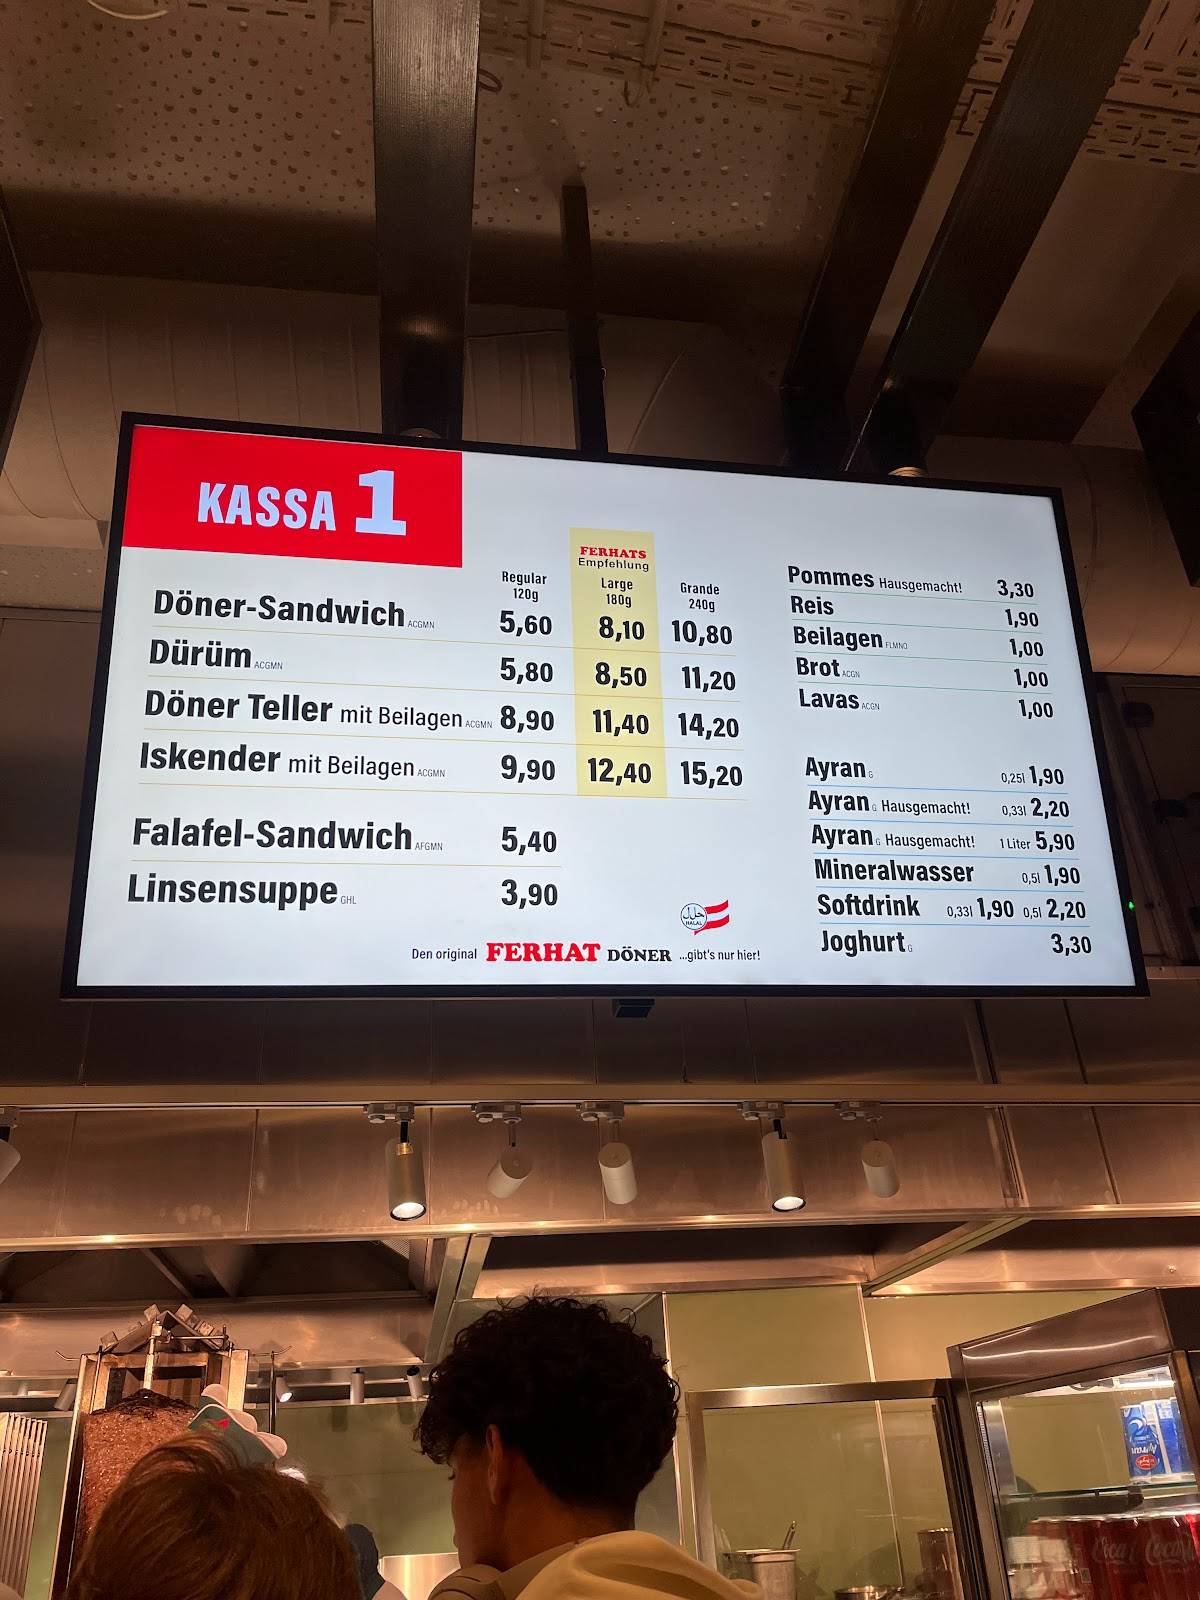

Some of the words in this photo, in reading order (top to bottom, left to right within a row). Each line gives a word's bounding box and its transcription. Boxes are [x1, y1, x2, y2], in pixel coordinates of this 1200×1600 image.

[197, 482, 336, 531] KASSA
[355, 469, 406, 536] 1
[578, 557, 649, 573] Empfehlung
[580, 546, 647, 560] FERHATS
[502, 570, 547, 586] Regular
[601, 577, 633, 593] Large
[680, 582, 720, 595] Grande
[787, 565, 875, 588] Pommes
[879, 577, 963, 594] Hausgemacht!
[996, 579, 1034, 599] 3,30
[154, 589, 405, 627] Döner-Sandwich
[513, 587, 539, 603] 120g
[606, 593, 632, 609] 180g
[688, 598, 715, 613] 240g
[790, 595, 834, 616] Reis
[499, 610, 552, 637] 5,60
[599, 615, 645, 643] 8,10
[1004, 608, 1039, 629] 1,90
[671, 619, 733, 647] 10,80
[793, 625, 883, 652] Beilagen
[149, 639, 252, 668] Dürüm
[1009, 638, 1044, 658] 1,00
[500, 657, 553, 685] 5,80
[595, 661, 647, 689] 8,50
[681, 666, 736, 693] 11,20
[796, 656, 841, 677] Brot
[1013, 668, 1049, 689] 1,00
[144, 689, 240, 719] Döner
[247, 693, 333, 722] Teller
[340, 705, 373, 724] mit
[379, 706, 462, 731] Beilagen
[798, 688, 860, 710] Lavas
[1018, 699, 1054, 720] 1,00
[500, 705, 555, 733] 8,90
[592, 709, 649, 737] 11,40
[678, 712, 739, 741] 14,20
[140, 741, 281, 772] Iskender
[288, 754, 322, 774] mit
[328, 755, 414, 781] Beilagen
[501, 754, 556, 784] 9,90
[587, 757, 652, 787] 12,40
[805, 756, 866, 782] Ayran
[680, 760, 743, 789] 15,20
[1001, 772, 1026, 785] 0,25l
[1028, 765, 1064, 787] 1,90
[808, 790, 870, 816] Ayran
[881, 799, 971, 816] Hausgemacht!
[1001, 805, 1027, 817] 0,33l
[1030, 797, 1070, 820] 2,20
[133, 817, 412, 850] Falafel-Sandwich
[501, 826, 557, 856] 5,40
[811, 824, 874, 850] Ayran
[885, 833, 975, 850] Hausgemacht!
[999, 838, 1005, 849] 1
[1006, 837, 1031, 850] Liter
[1035, 830, 1075, 853] 5,90
[814, 858, 975, 882] Mineralwasser
[1021, 872, 1041, 885] 0,5l
[1043, 864, 1081, 887] 1,90
[127, 872, 338, 911] Linsensuppe
[501, 879, 558, 910] 3,90
[817, 893, 921, 917] Softdrink
[946, 905, 973, 919] 0,33l
[976, 897, 1014, 921] 1,90
[1023, 906, 1042, 920] 0,5l
[1046, 898, 1086, 921] 2,20
[412, 948, 433, 960] Den
[435, 948, 477, 962] original
[486, 942, 601, 962] FERHAT
[607, 946, 673, 962] DÖNER
[718, 951, 735, 960] nur
[737, 949, 761, 961] hier!
[821, 929, 906, 958] Joghurt
[1050, 933, 1092, 957] 3,30
